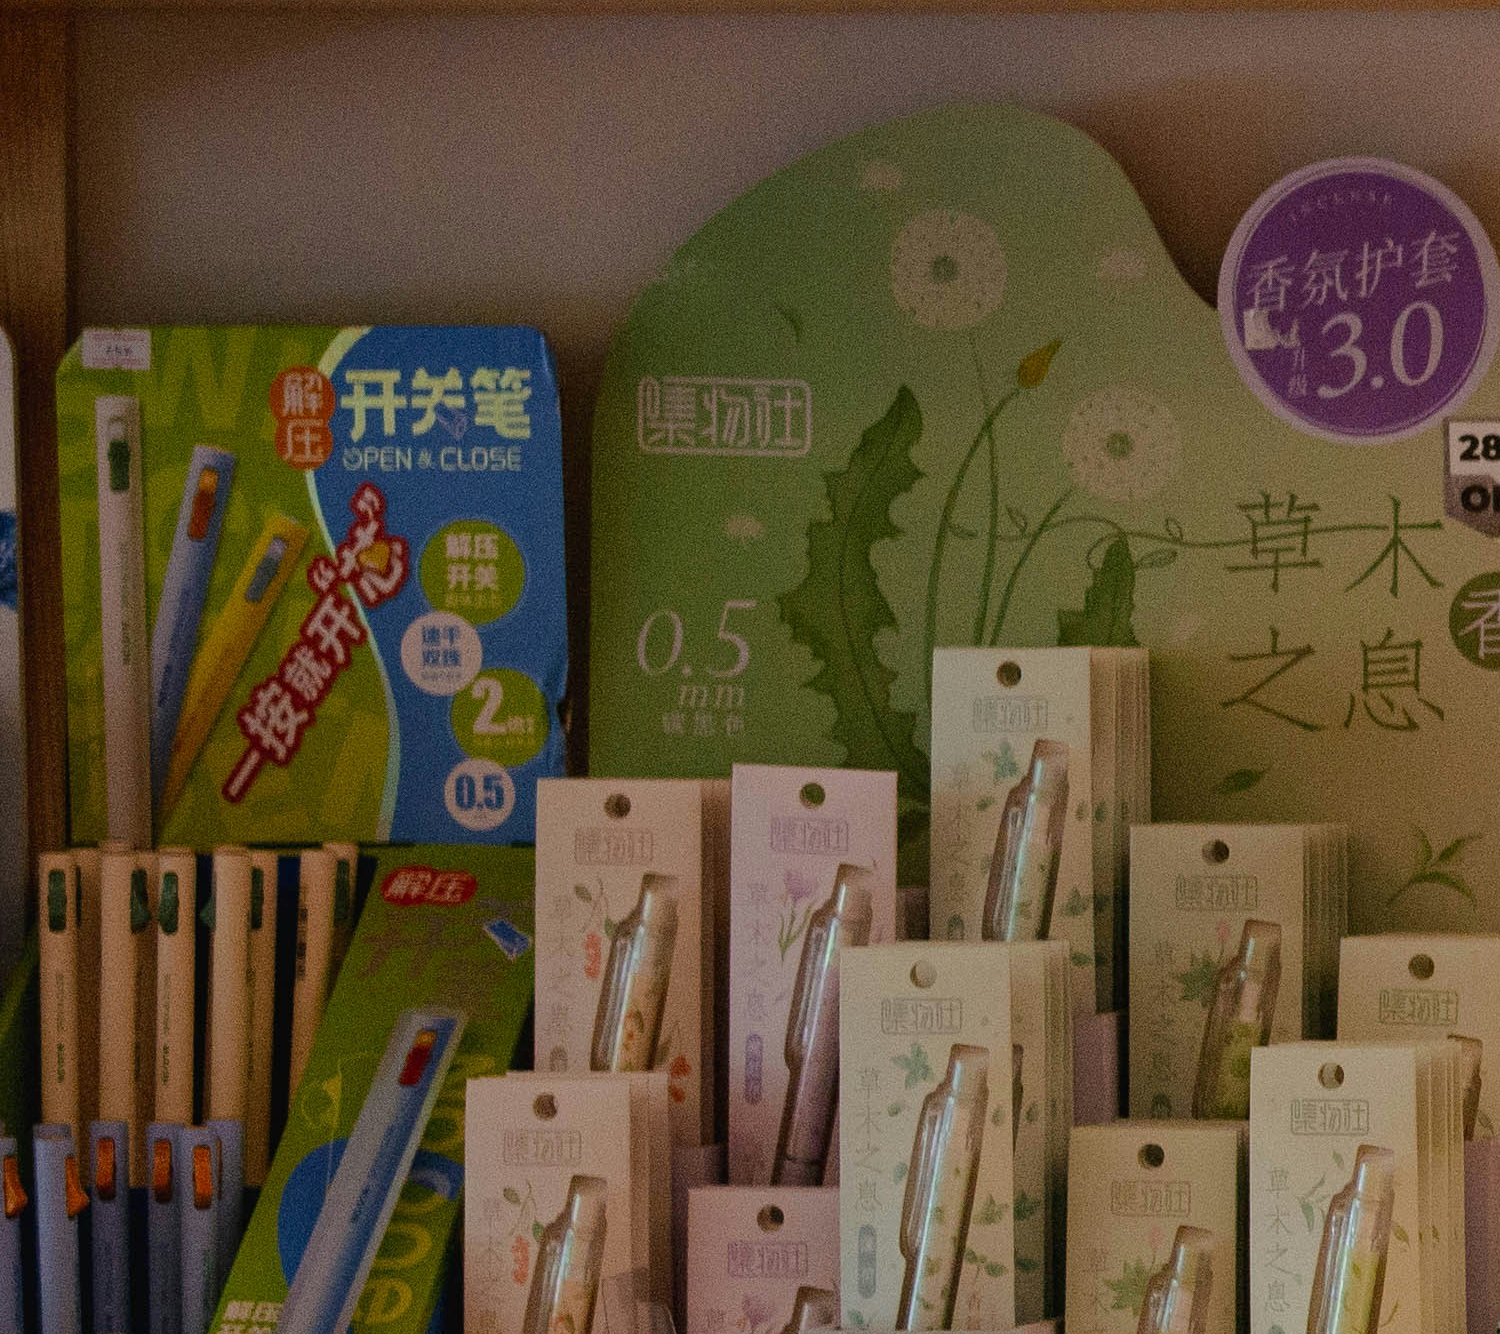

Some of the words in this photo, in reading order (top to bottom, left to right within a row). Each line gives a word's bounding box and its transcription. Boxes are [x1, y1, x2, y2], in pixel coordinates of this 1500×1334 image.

[1316, 299, 1445, 401] 3.0
[340, 365, 533, 440] 开关笔
[439, 447, 523, 472] CLOSE
[635, 598, 760, 680] 0.5
[675, 682, 748, 711] mm
[454, 773, 505, 811] 0.5
